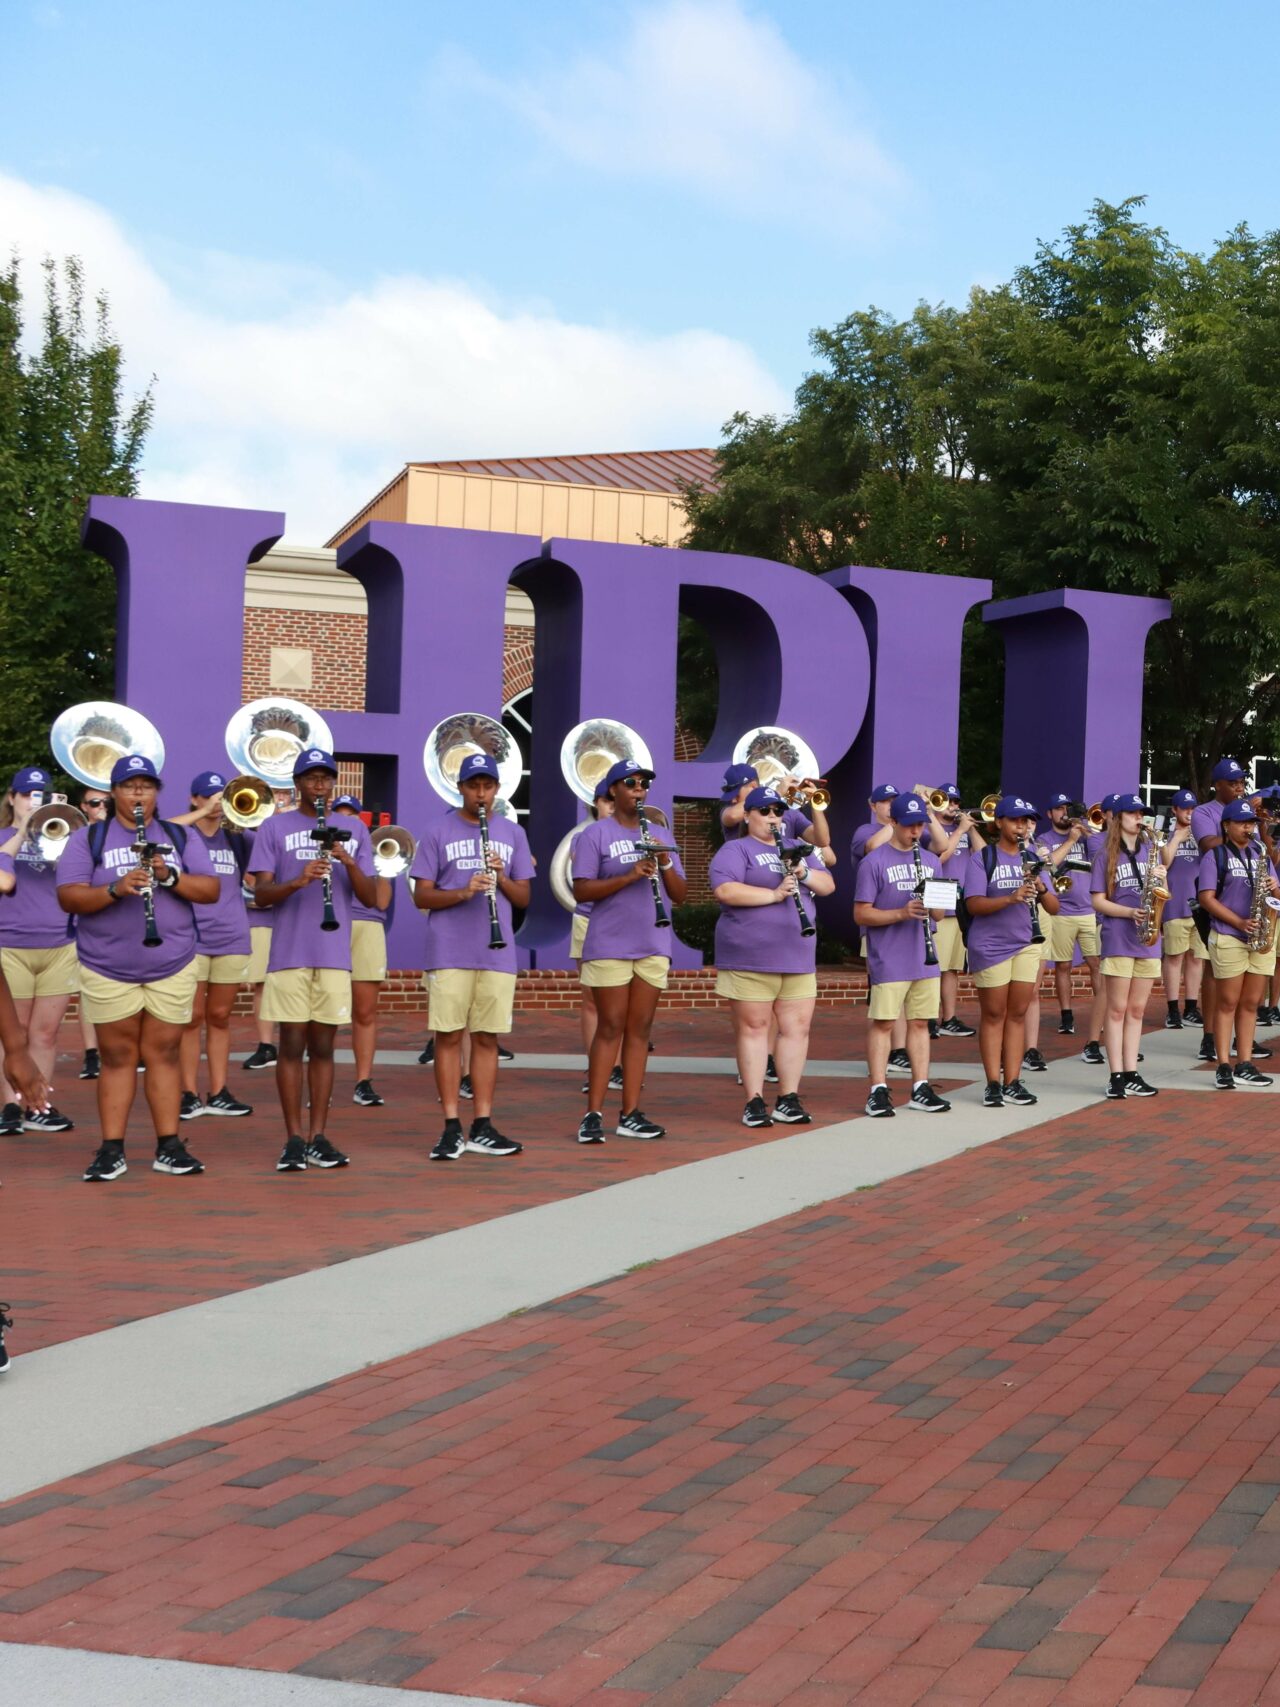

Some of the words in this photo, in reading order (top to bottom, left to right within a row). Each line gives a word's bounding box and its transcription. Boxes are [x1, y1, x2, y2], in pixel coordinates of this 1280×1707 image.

[209, 849, 238, 867] POIN
[445, 839, 475, 862] HIGH
[886, 864, 910, 883] HIGH
